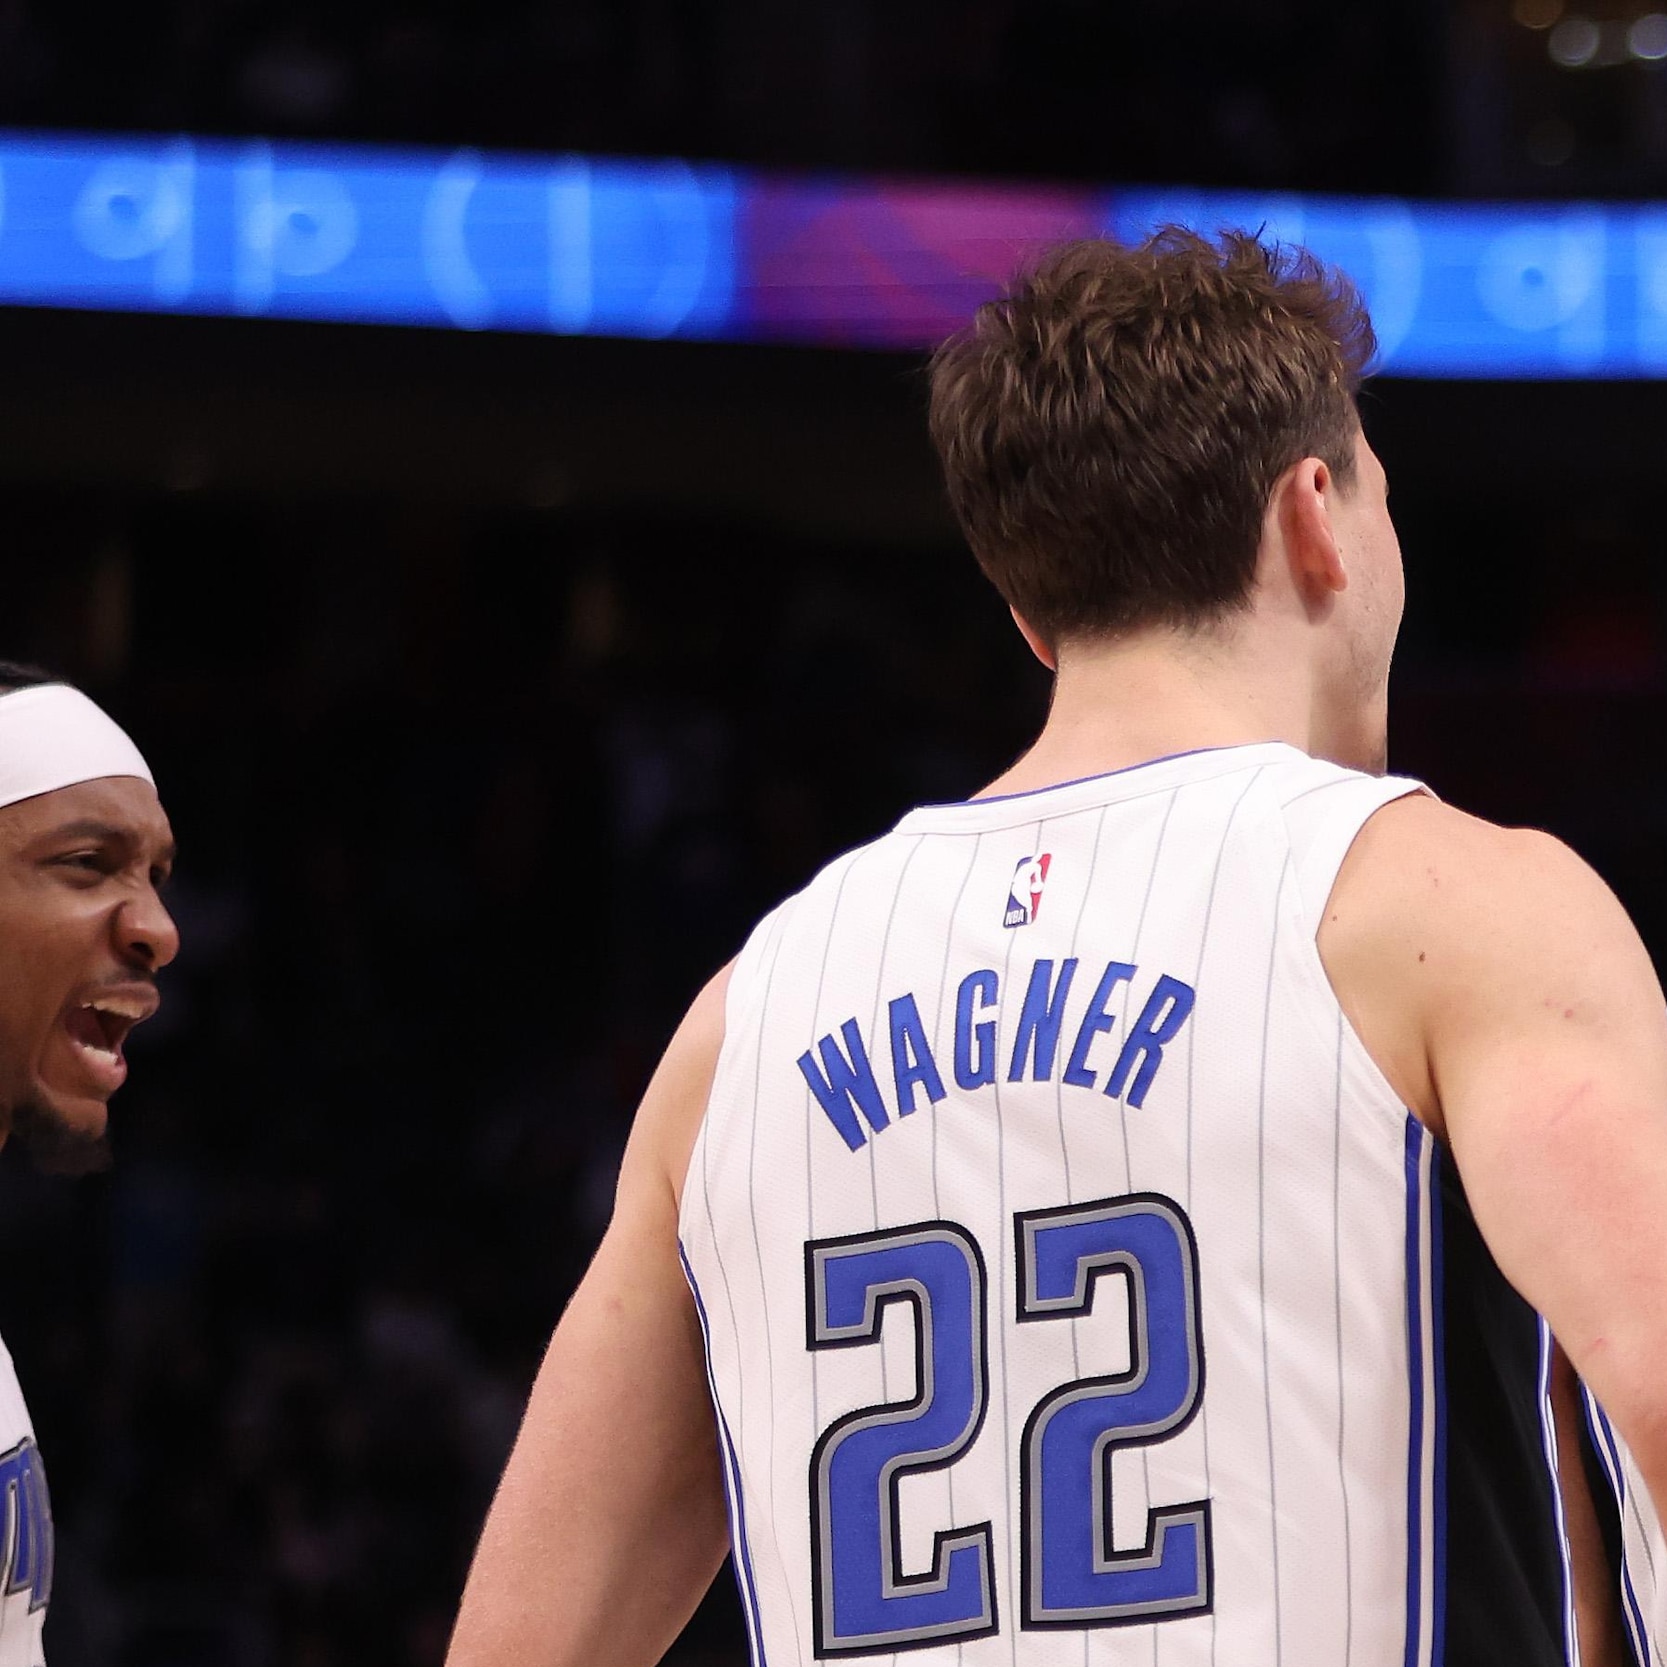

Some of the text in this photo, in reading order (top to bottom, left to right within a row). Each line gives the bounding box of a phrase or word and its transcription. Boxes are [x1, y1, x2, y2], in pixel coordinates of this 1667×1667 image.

[1005, 908, 1025, 925] NBA
[796, 958, 1197, 1153] WAGNER
[804, 1191, 1215, 1661] 22
